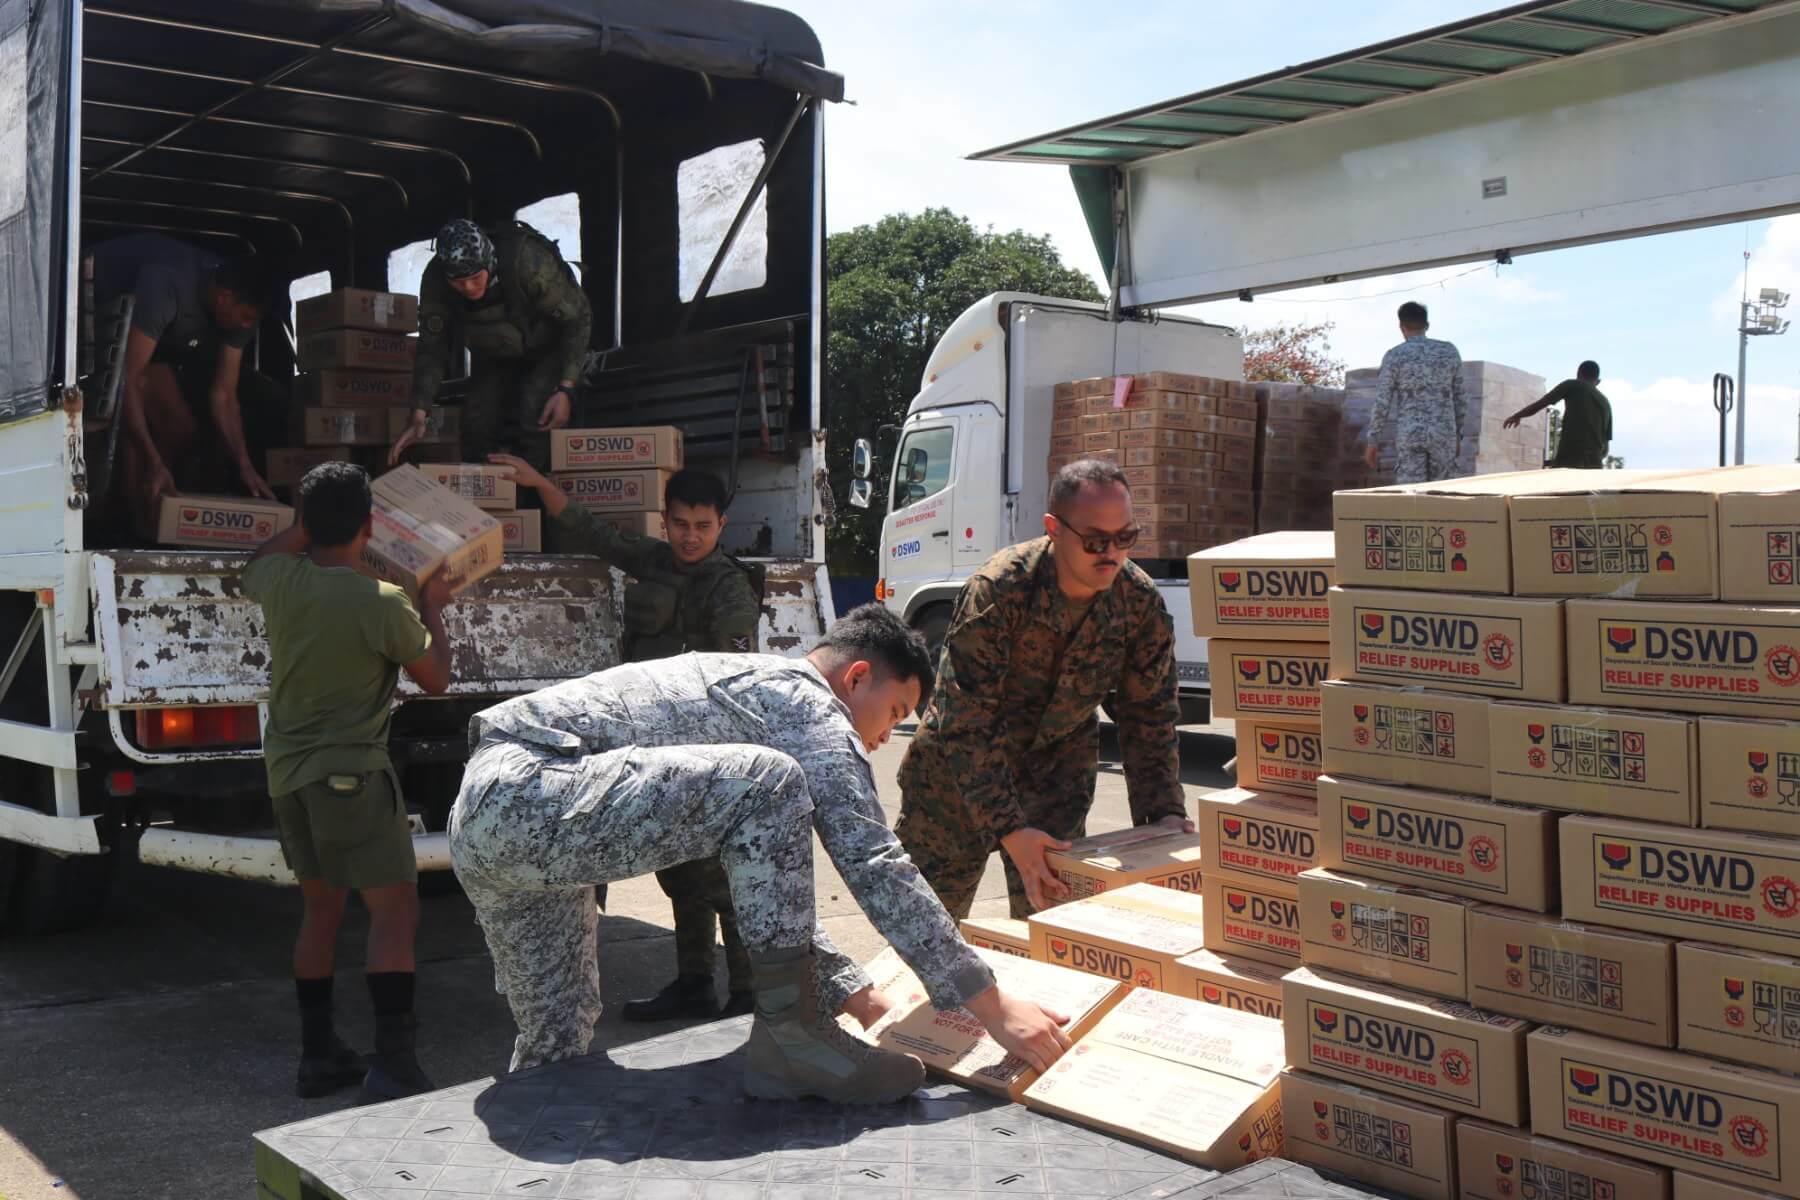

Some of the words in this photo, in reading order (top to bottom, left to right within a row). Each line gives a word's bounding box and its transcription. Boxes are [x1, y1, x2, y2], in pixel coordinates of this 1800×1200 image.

[587, 437, 634, 451] DSWD
[577, 479, 623, 492] DSWD
[202, 511, 254, 529] DSWD
[898, 541, 920, 556] DSWD
[1247, 571, 1328, 596] DSWD
[1219, 606, 1263, 617] RELIEF
[1267, 607, 1329, 618] SUPPLIES
[1391, 615, 1479, 650] DSWD
[1646, 627, 1758, 663] DSWD
[1267, 660, 1328, 687] DSW
[1360, 651, 1406, 667] RELIEF
[1411, 656, 1480, 676] SUPPLIES
[1605, 669, 1664, 686] RELIEF
[1670, 673, 1759, 693] SUPPLIES
[1239, 693, 1283, 705] RELIEF
[1287, 696, 1321, 707] SUPP
[1260, 764, 1298, 780] RELIEF
[1246, 822, 1315, 858] DSWD
[1377, 808, 1464, 850] DSWD
[1222, 850, 1259, 867] RELIEF
[1262, 859, 1311, 876] SUPPL
[1346, 842, 1392, 861] RELIEF
[1396, 853, 1465, 875] SUPPLIES
[1640, 846, 1754, 892] DSWD
[1168, 870, 1202, 892] DSW
[1252, 897, 1300, 928] DSW
[1599, 885, 1659, 906] RELIEF
[1665, 895, 1756, 922] SUPPLIES
[1226, 924, 1264, 942] RELIEF
[1268, 934, 1300, 950] SUPP
[1072, 944, 1132, 980] DSWD
[1227, 991, 1282, 1019] DSW
[936, 1017, 954, 1029] NOT
[952, 1023, 973, 1035] FOR
[1345, 1014, 1435, 1061] DSWD
[1152, 1039, 1186, 1053] WITH
[1313, 1043, 1361, 1068] RELIEF
[1366, 1057, 1437, 1087] SUPPLIES
[1608, 1074, 1723, 1128] DSWD
[1567, 1108, 1628, 1132] RELIEF
[1634, 1124, 1724, 1157] SUPPLIES
